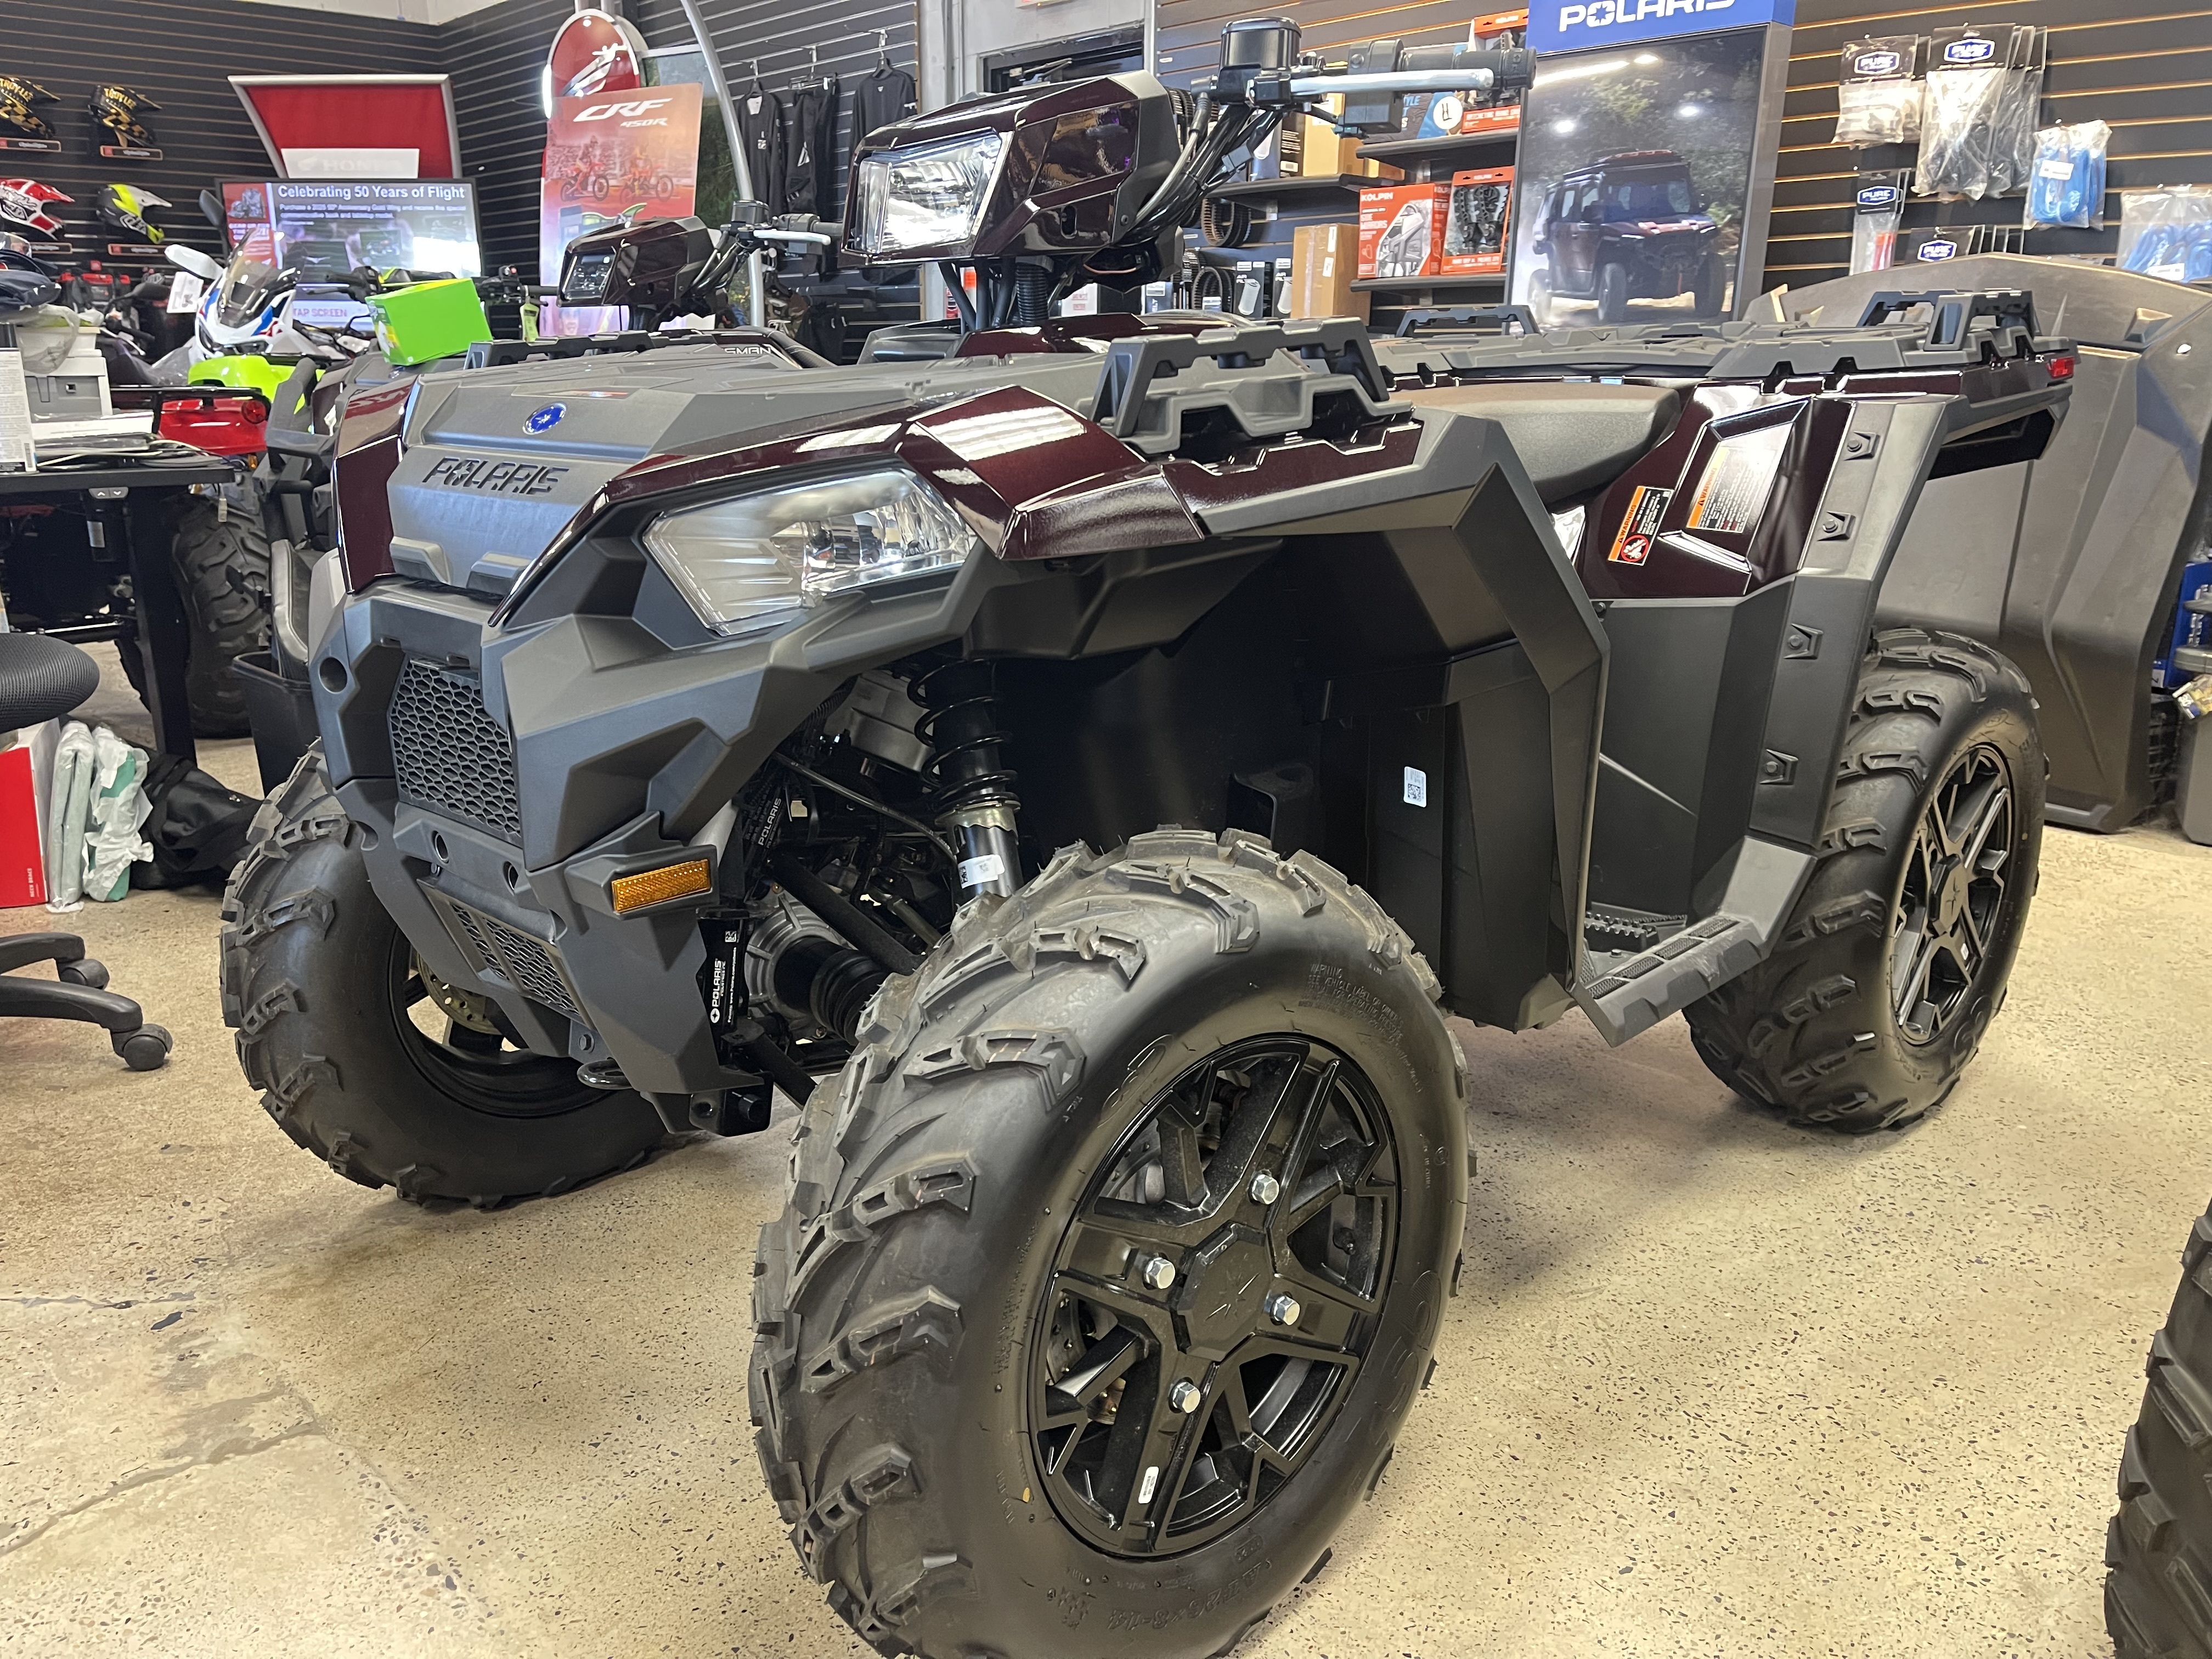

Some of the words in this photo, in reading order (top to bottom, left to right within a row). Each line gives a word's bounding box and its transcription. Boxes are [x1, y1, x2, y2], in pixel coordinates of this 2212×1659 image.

[573, 98, 673, 122] CRF
[620, 117, 668, 127] 450R
[278, 185, 352, 200] Celebrating
[354, 185, 369, 198] 50
[373, 186, 408, 198] Years
[411, 185, 425, 198] of
[427, 187, 465, 201] Flight
[1361, 193, 1394, 202] KOLPIN
[1863, 190, 1891, 199] PURE
[293, 308, 309, 317] TAP
[311, 308, 347, 317] SCREEN
[422, 456, 569, 495] POLARIS
[1701, 467, 1717, 500] WARNING
[1621, 505, 1637, 537] WARNING
[758, 797, 782, 846] POLARIS
[712, 960, 721, 1007] POLARIS
